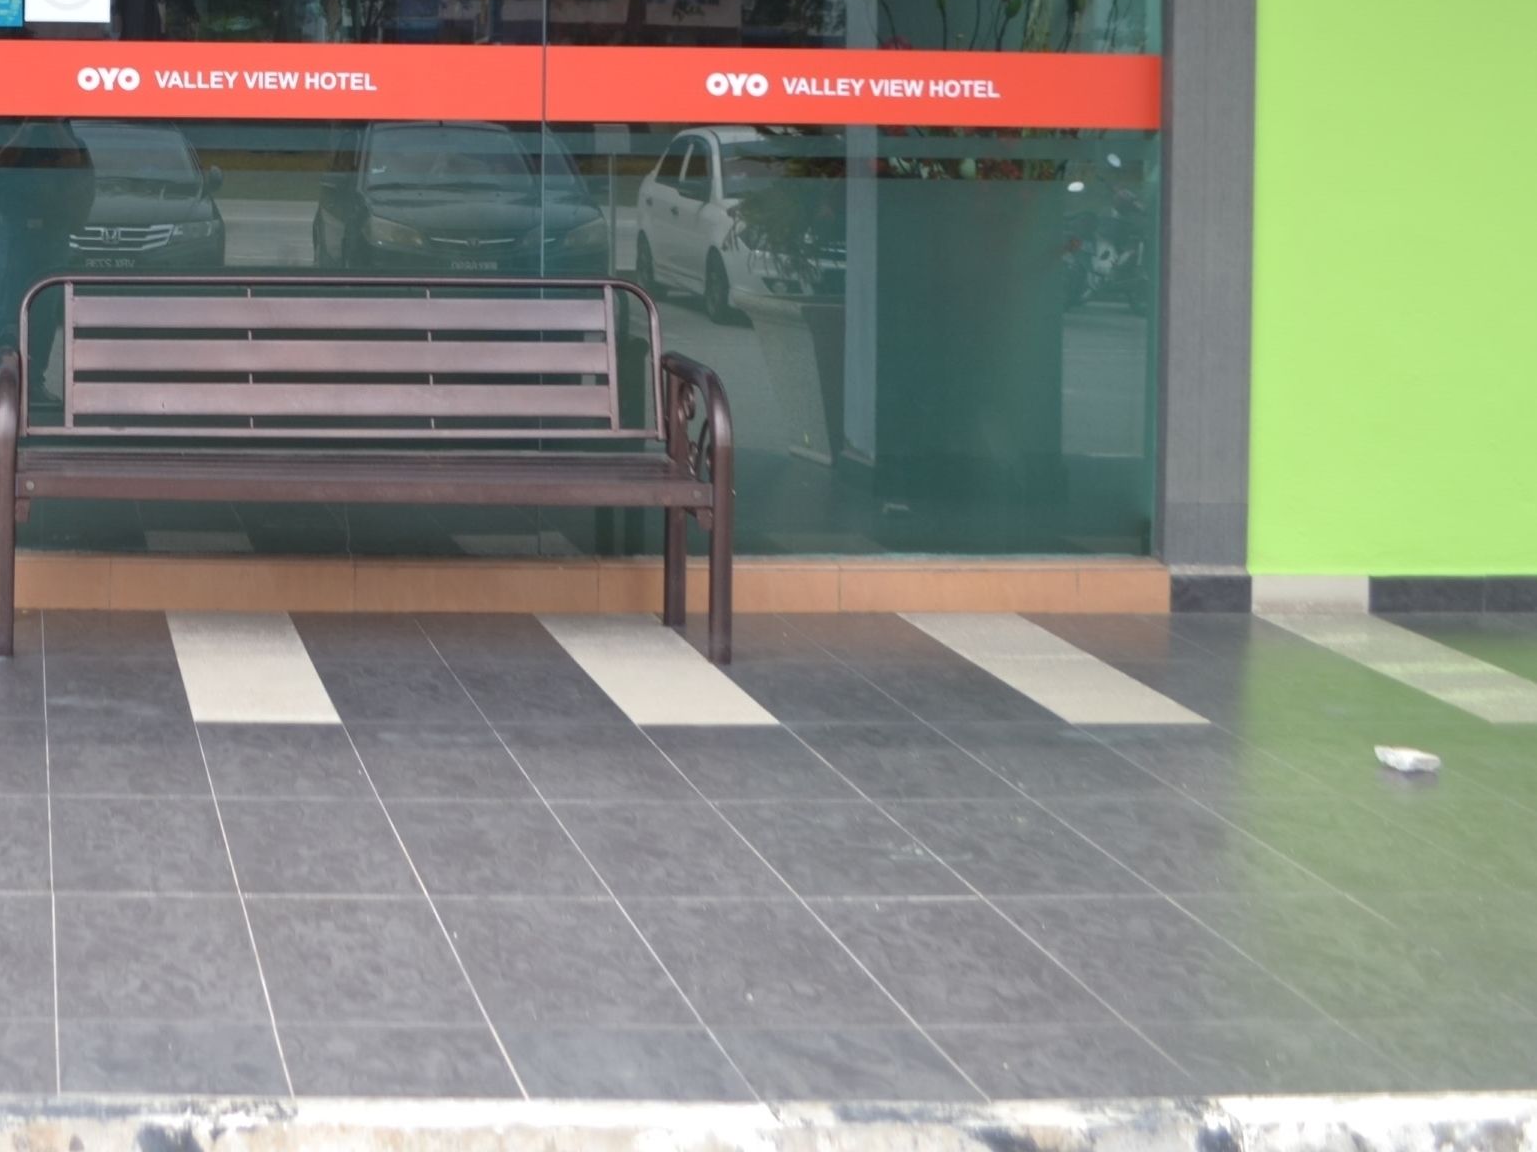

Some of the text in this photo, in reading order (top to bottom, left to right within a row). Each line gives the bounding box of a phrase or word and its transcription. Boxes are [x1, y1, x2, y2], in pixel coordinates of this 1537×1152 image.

[77, 67, 378, 92] OYO VALLEY VIEW HOTEL
[705, 72, 1001, 99] OYO VALLEY VIEW HOTEL
